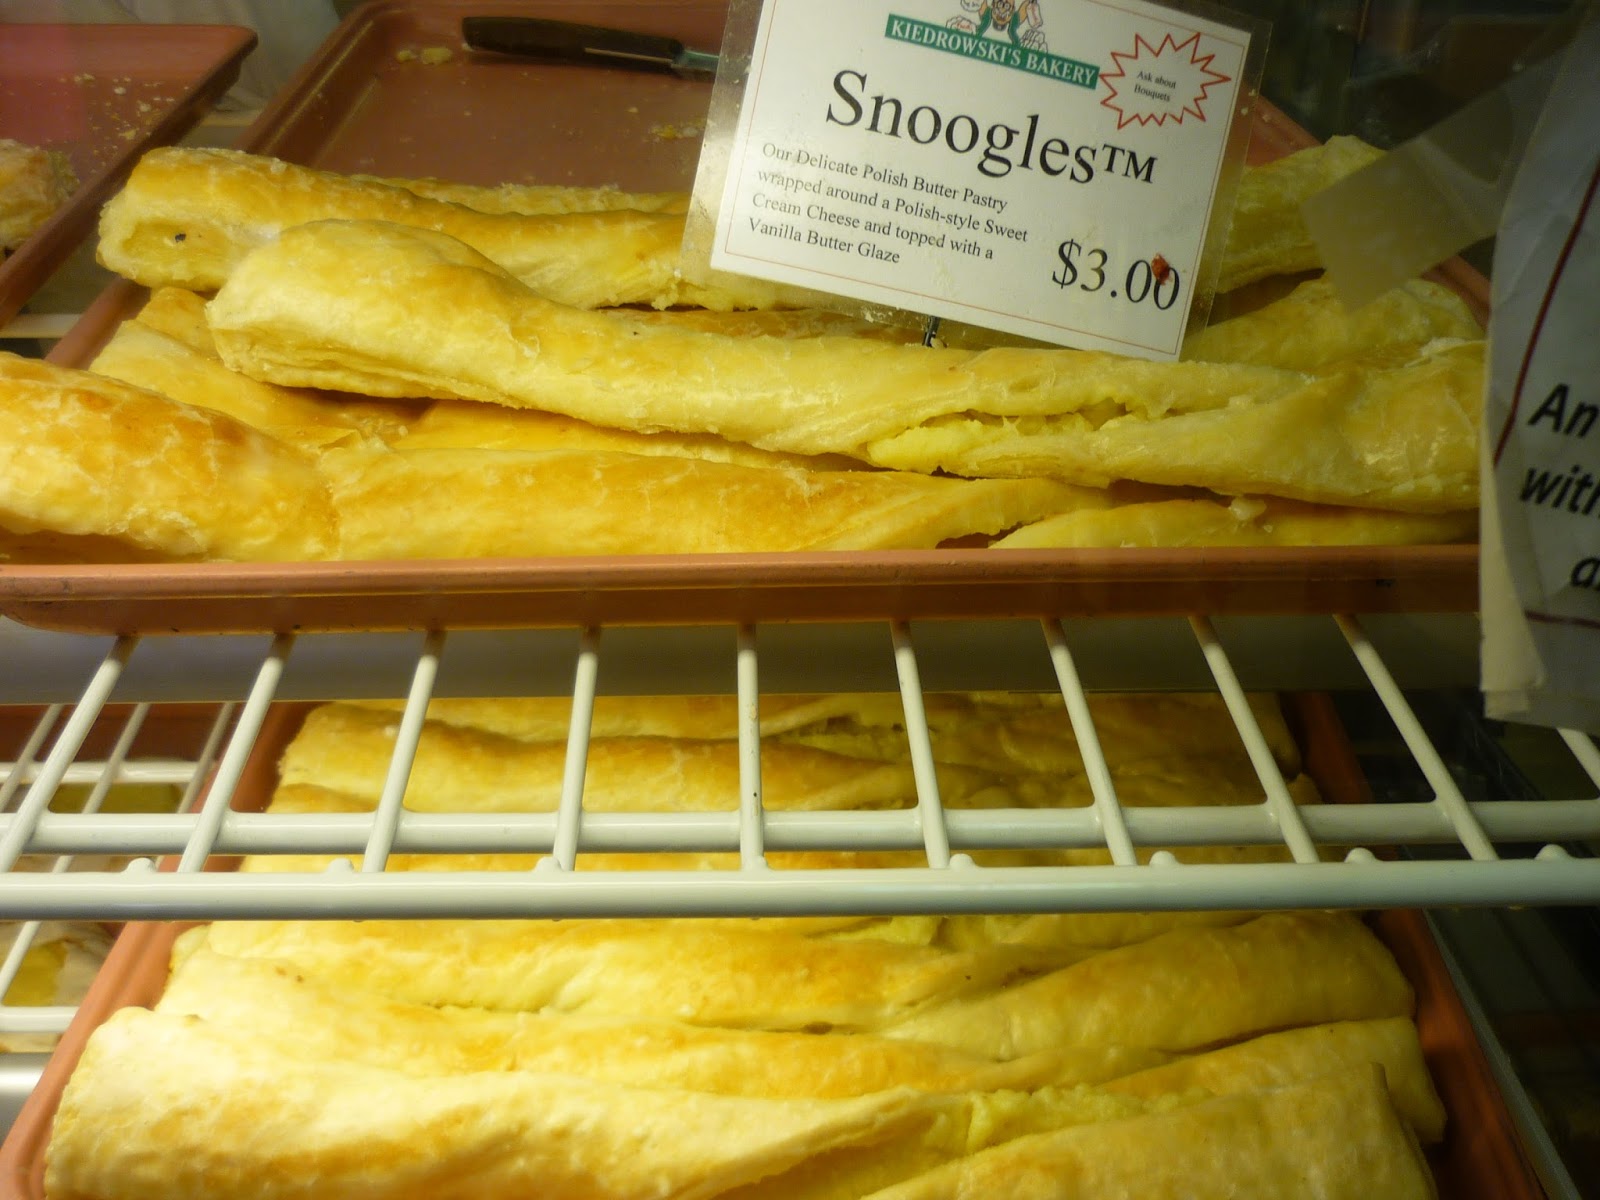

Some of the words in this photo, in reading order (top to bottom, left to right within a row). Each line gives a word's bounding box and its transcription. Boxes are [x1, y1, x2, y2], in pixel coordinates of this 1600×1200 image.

[891, 18, 1021, 67] KIEDROWSKI'S
[1025, 53, 1096, 86] BAKERY
[1136, 70, 1153, 83] Ask
[1154, 76, 1177, 90] about
[1134, 83, 1171, 103] Bouquets
[757, 170, 822, 195] wrapped
[826, 186, 879, 208] around
[881, 199, 890, 210] a
[894, 198, 981, 231] Polish-style
[984, 219, 1029, 243] Sweet
[762, 142, 793, 162] Our
[796, 149, 859, 177] Delicate
[862, 164, 909, 189] Polish
[912, 176, 961, 201] Butter
[963, 188, 1008, 215] Pastry
[749, 216, 802, 243] Vanilla
[806, 230, 854, 254] Butter
[857, 242, 901, 264] Glaze
[752, 192, 802, 217] Cream
[806, 204, 861, 229] Cheese
[864, 221, 893, 237] and
[895, 226, 946, 248] topped
[950, 239, 981, 258] with
[985, 249, 994, 260] a
[1051, 238, 1181, 311] $3.00
